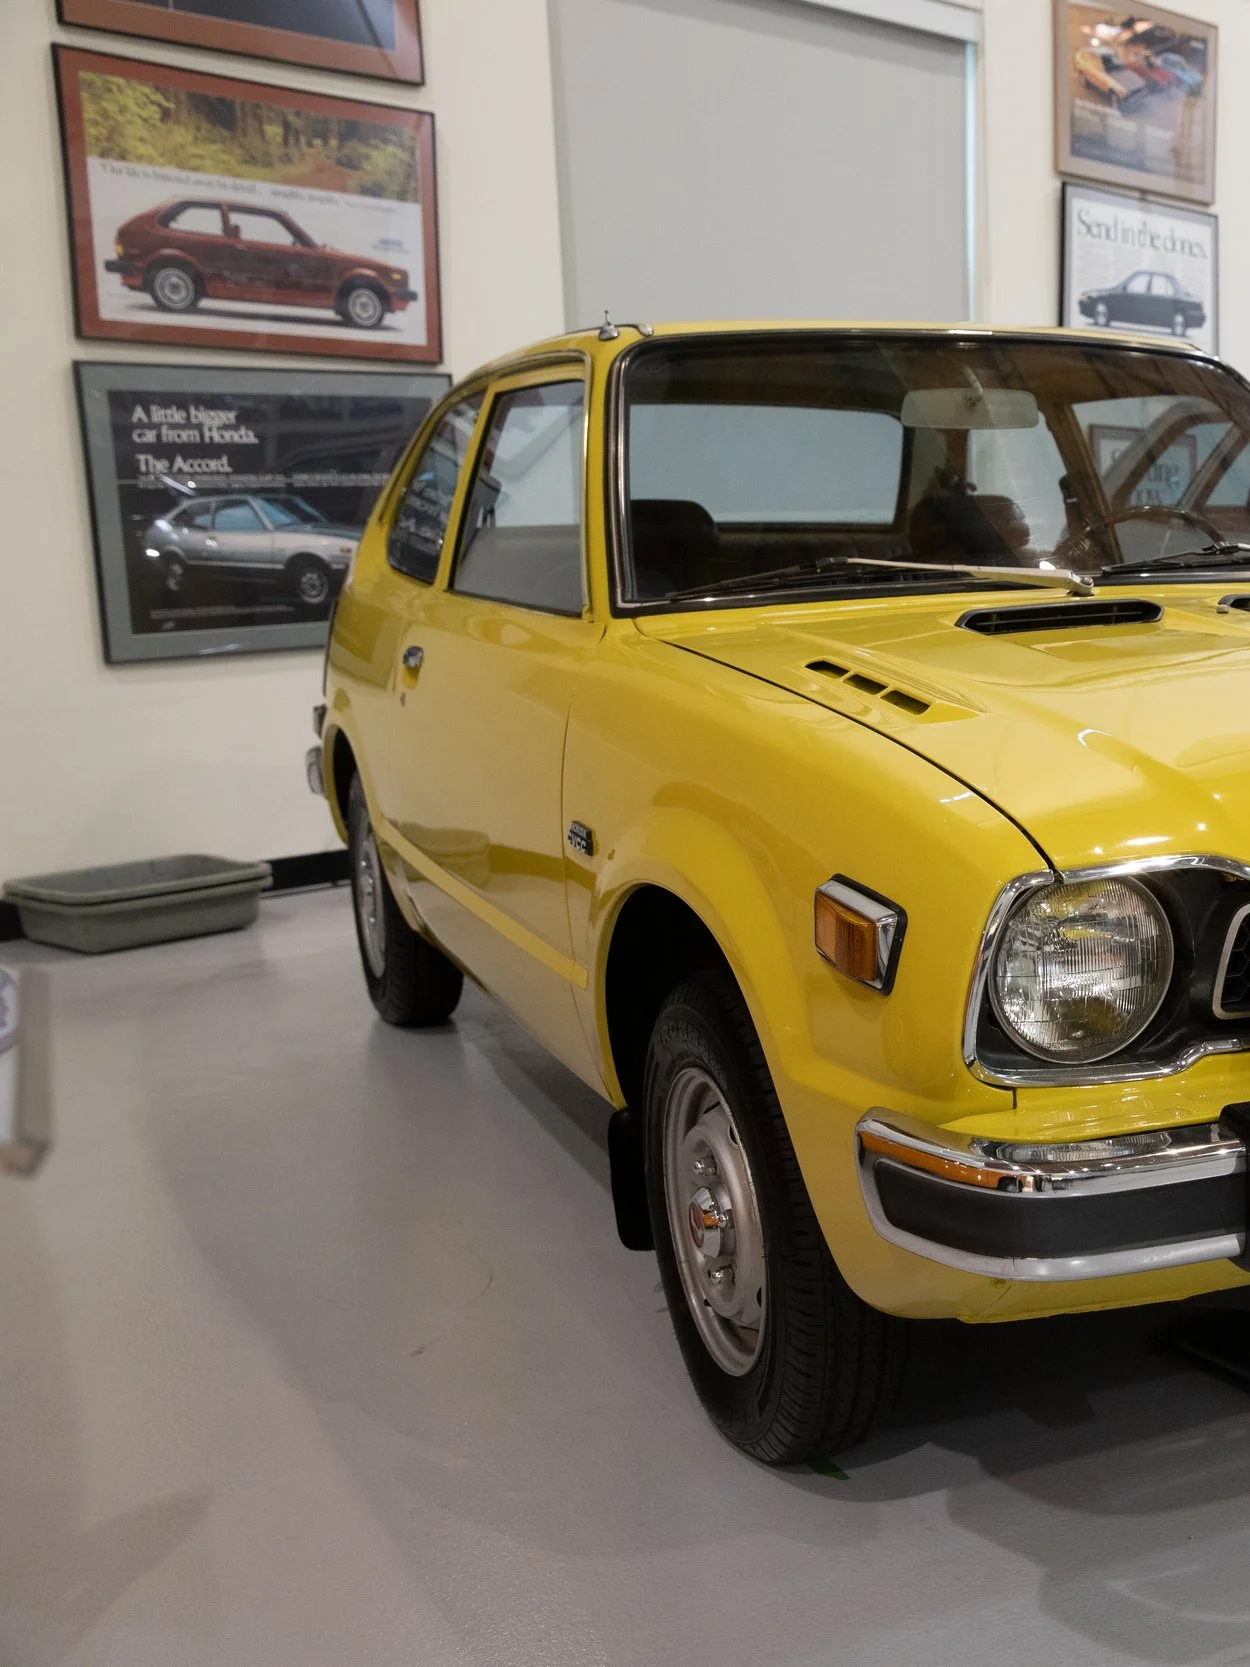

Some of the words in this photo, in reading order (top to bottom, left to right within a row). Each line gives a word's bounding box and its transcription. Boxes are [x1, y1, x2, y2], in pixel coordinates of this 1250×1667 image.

[1077, 207, 1118, 243] Send
[131, 404, 149, 423] A
[150, 403, 188, 424] little
[188, 404, 239, 427] bigger
[132, 428, 159, 443] car
[160, 424, 200, 444] from
[203, 424, 259, 444] Honda.
[135, 453, 171, 474] The
[171, 454, 233, 473] Accord.
